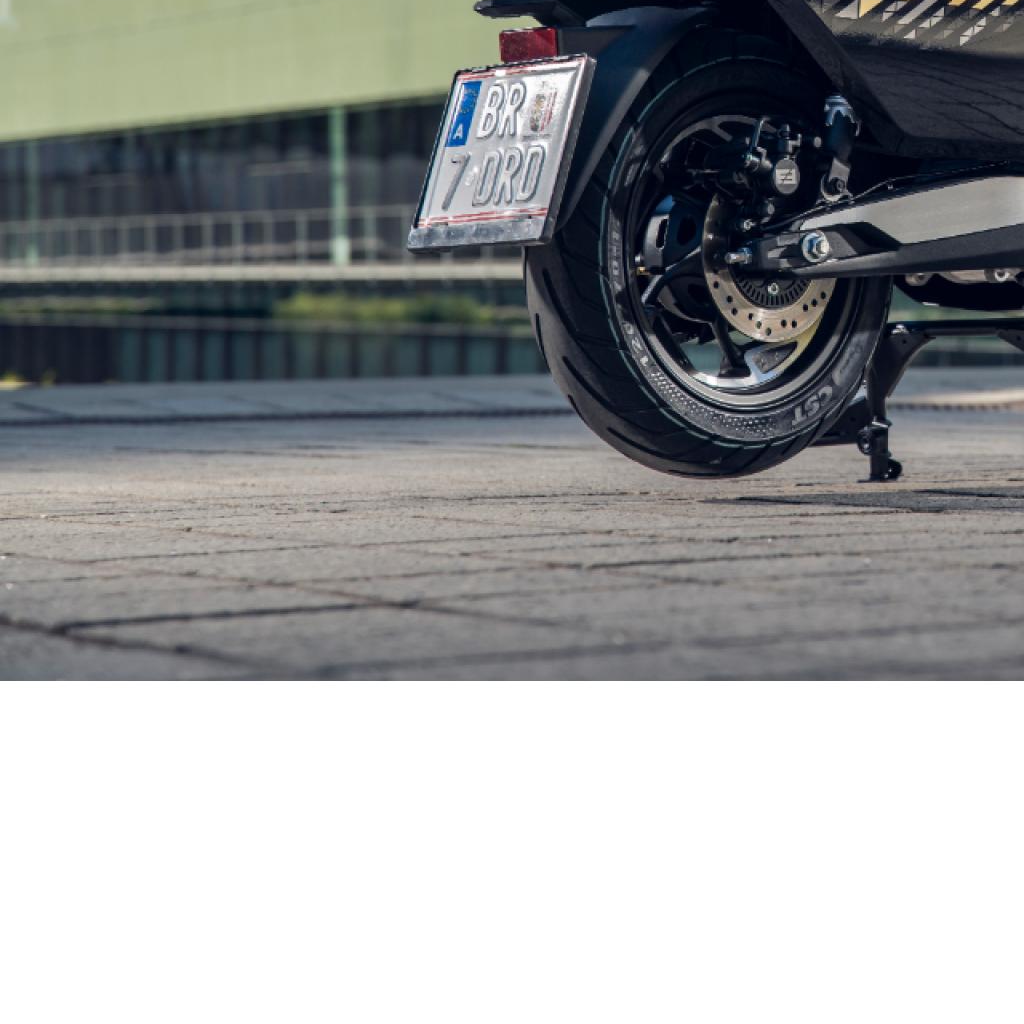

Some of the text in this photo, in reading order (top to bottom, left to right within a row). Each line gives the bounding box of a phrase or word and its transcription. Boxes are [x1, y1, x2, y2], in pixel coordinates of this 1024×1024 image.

[453, 125, 465, 140] A
[476, 81, 527, 139] BR
[441, 153, 471, 211] 7
[792, 386, 834, 425] CST
